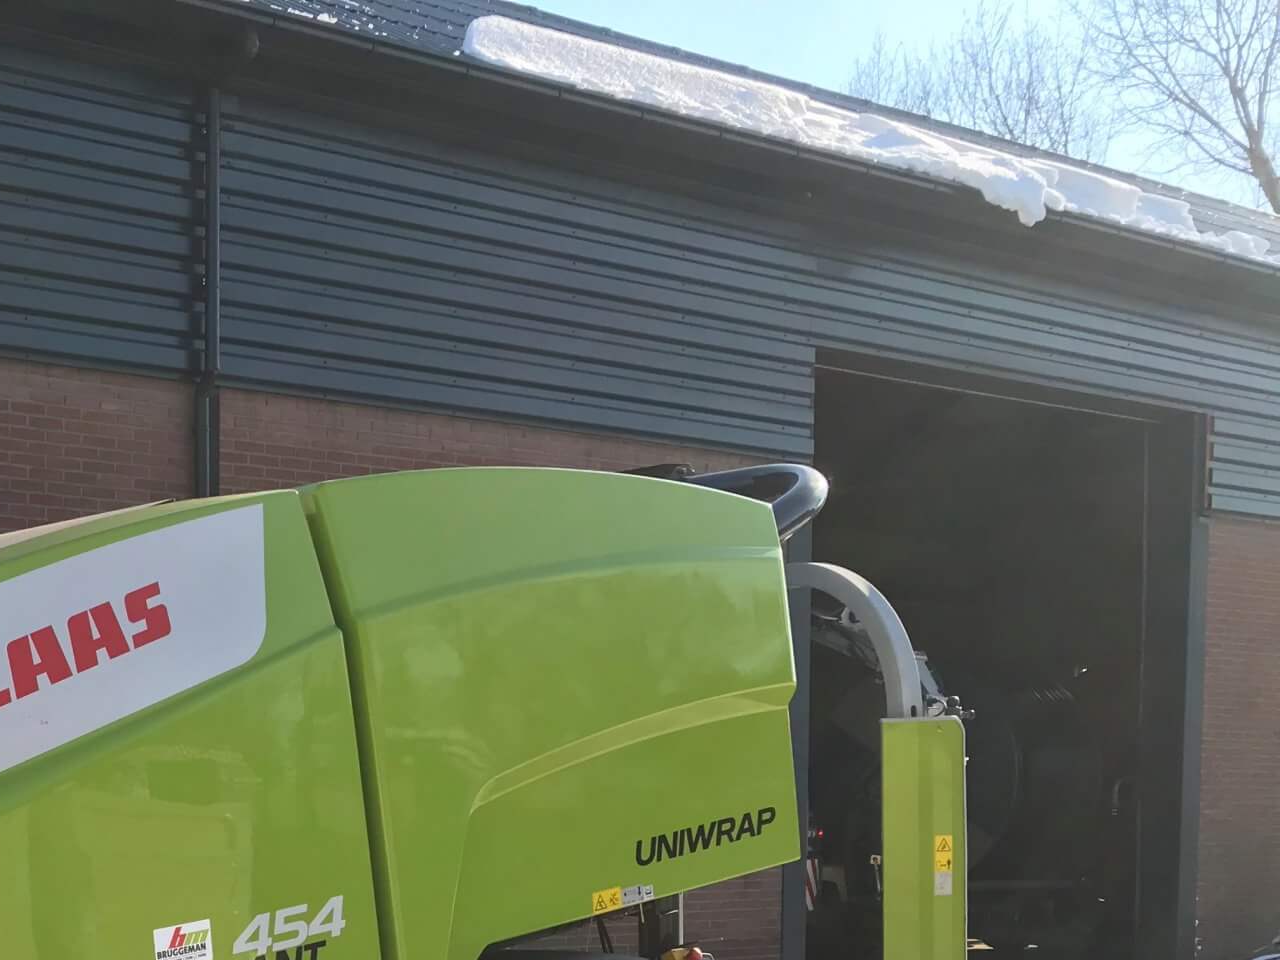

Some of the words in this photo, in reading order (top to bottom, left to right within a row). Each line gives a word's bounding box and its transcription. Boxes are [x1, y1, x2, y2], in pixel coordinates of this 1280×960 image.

[635, 806, 777, 866] UNIWRAP
[156, 942, 207, 960] BRUGGEMAN
[232, 895, 346, 955] 454
